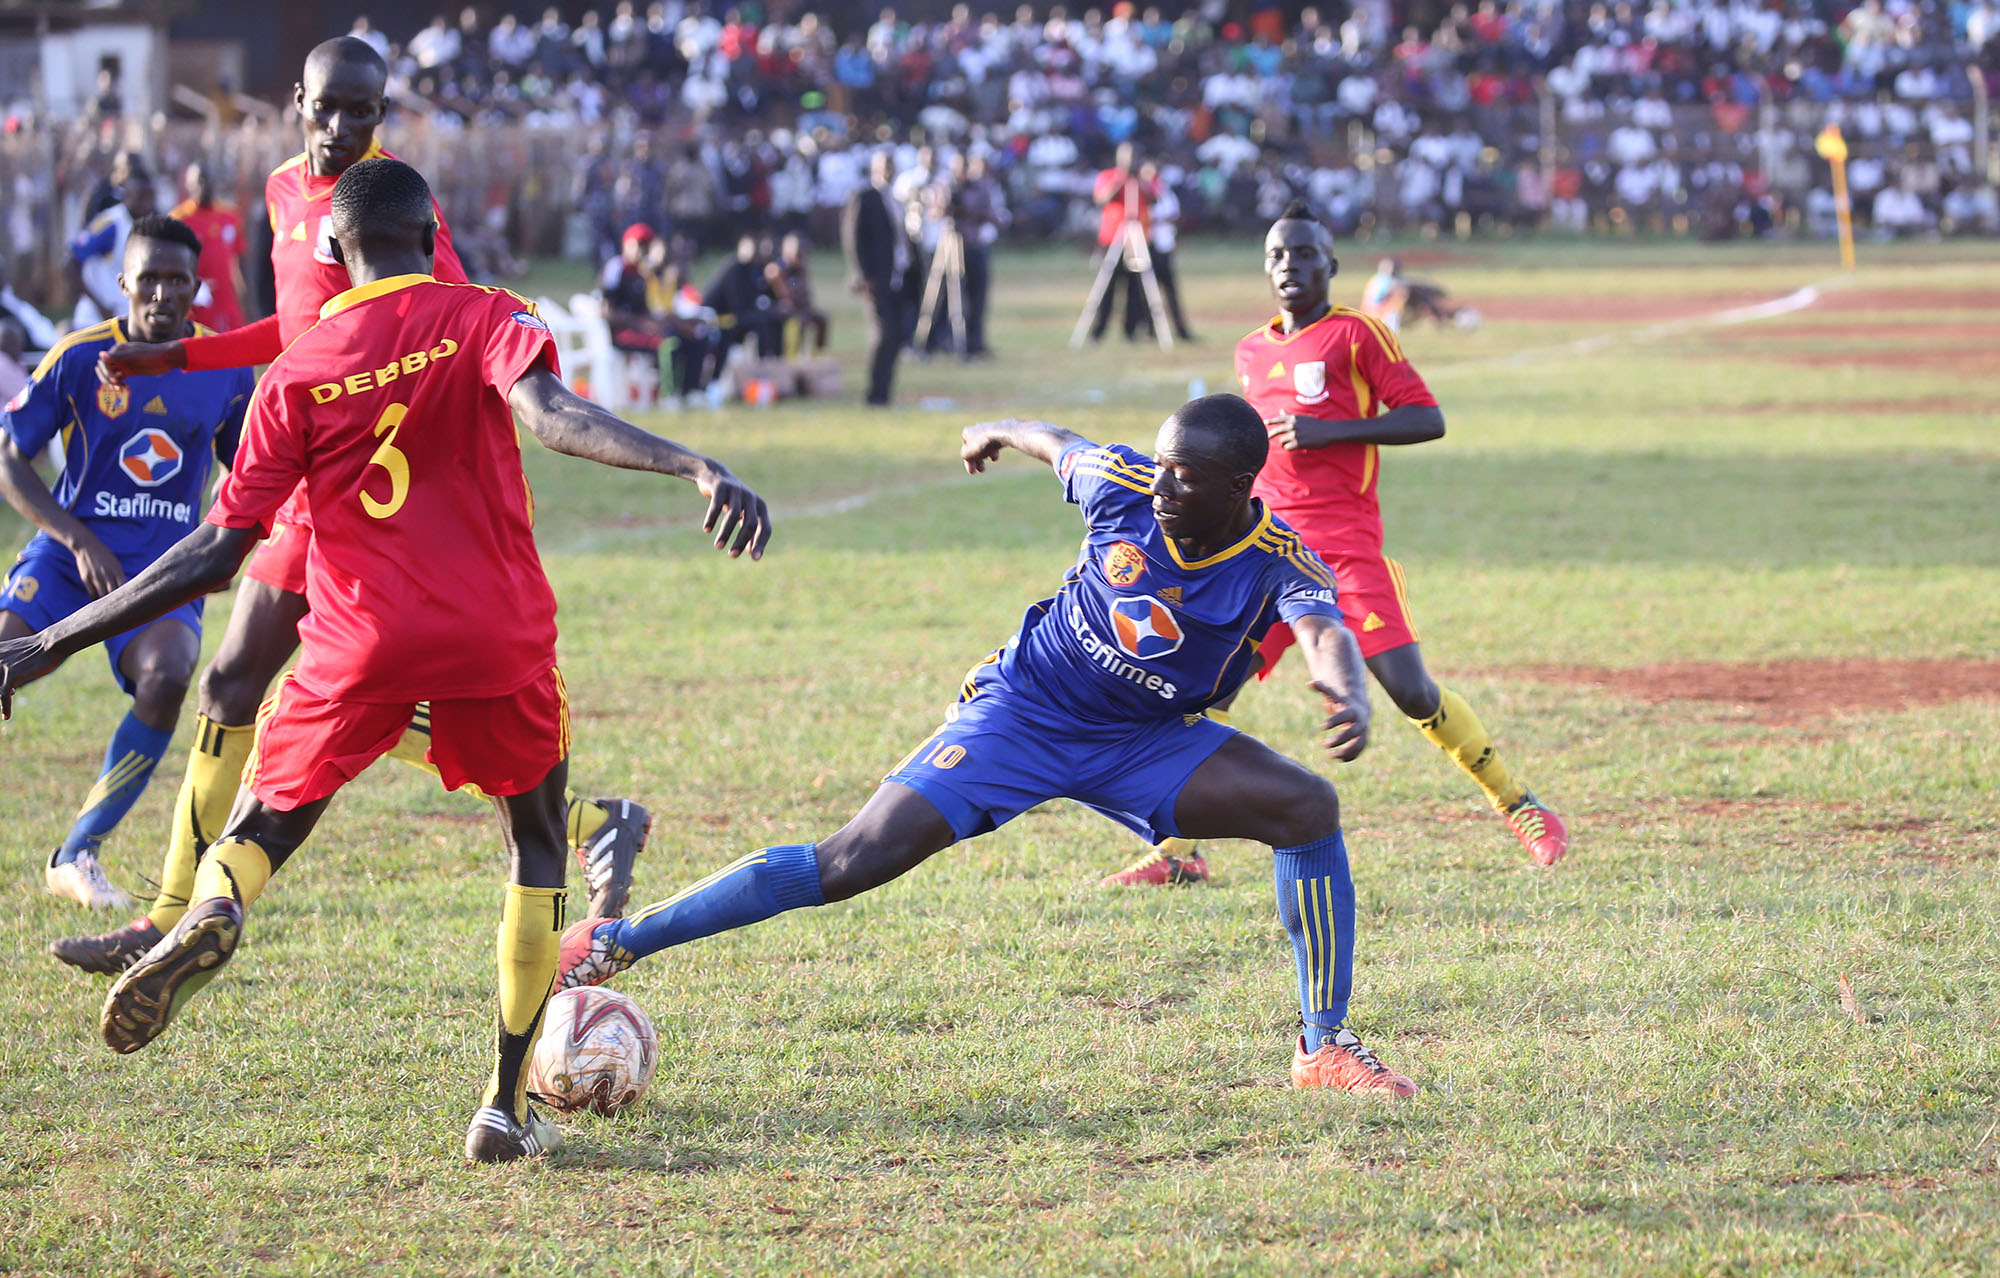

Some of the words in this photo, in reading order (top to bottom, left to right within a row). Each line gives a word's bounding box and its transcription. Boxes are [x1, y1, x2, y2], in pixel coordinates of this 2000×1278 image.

[309, 338, 459, 405] DEBBO
[358, 402, 411, 519] 3
[8, 575, 39, 603] 13
[1068, 604, 1178, 700] StarTimes
[920, 740, 967, 770] 10
